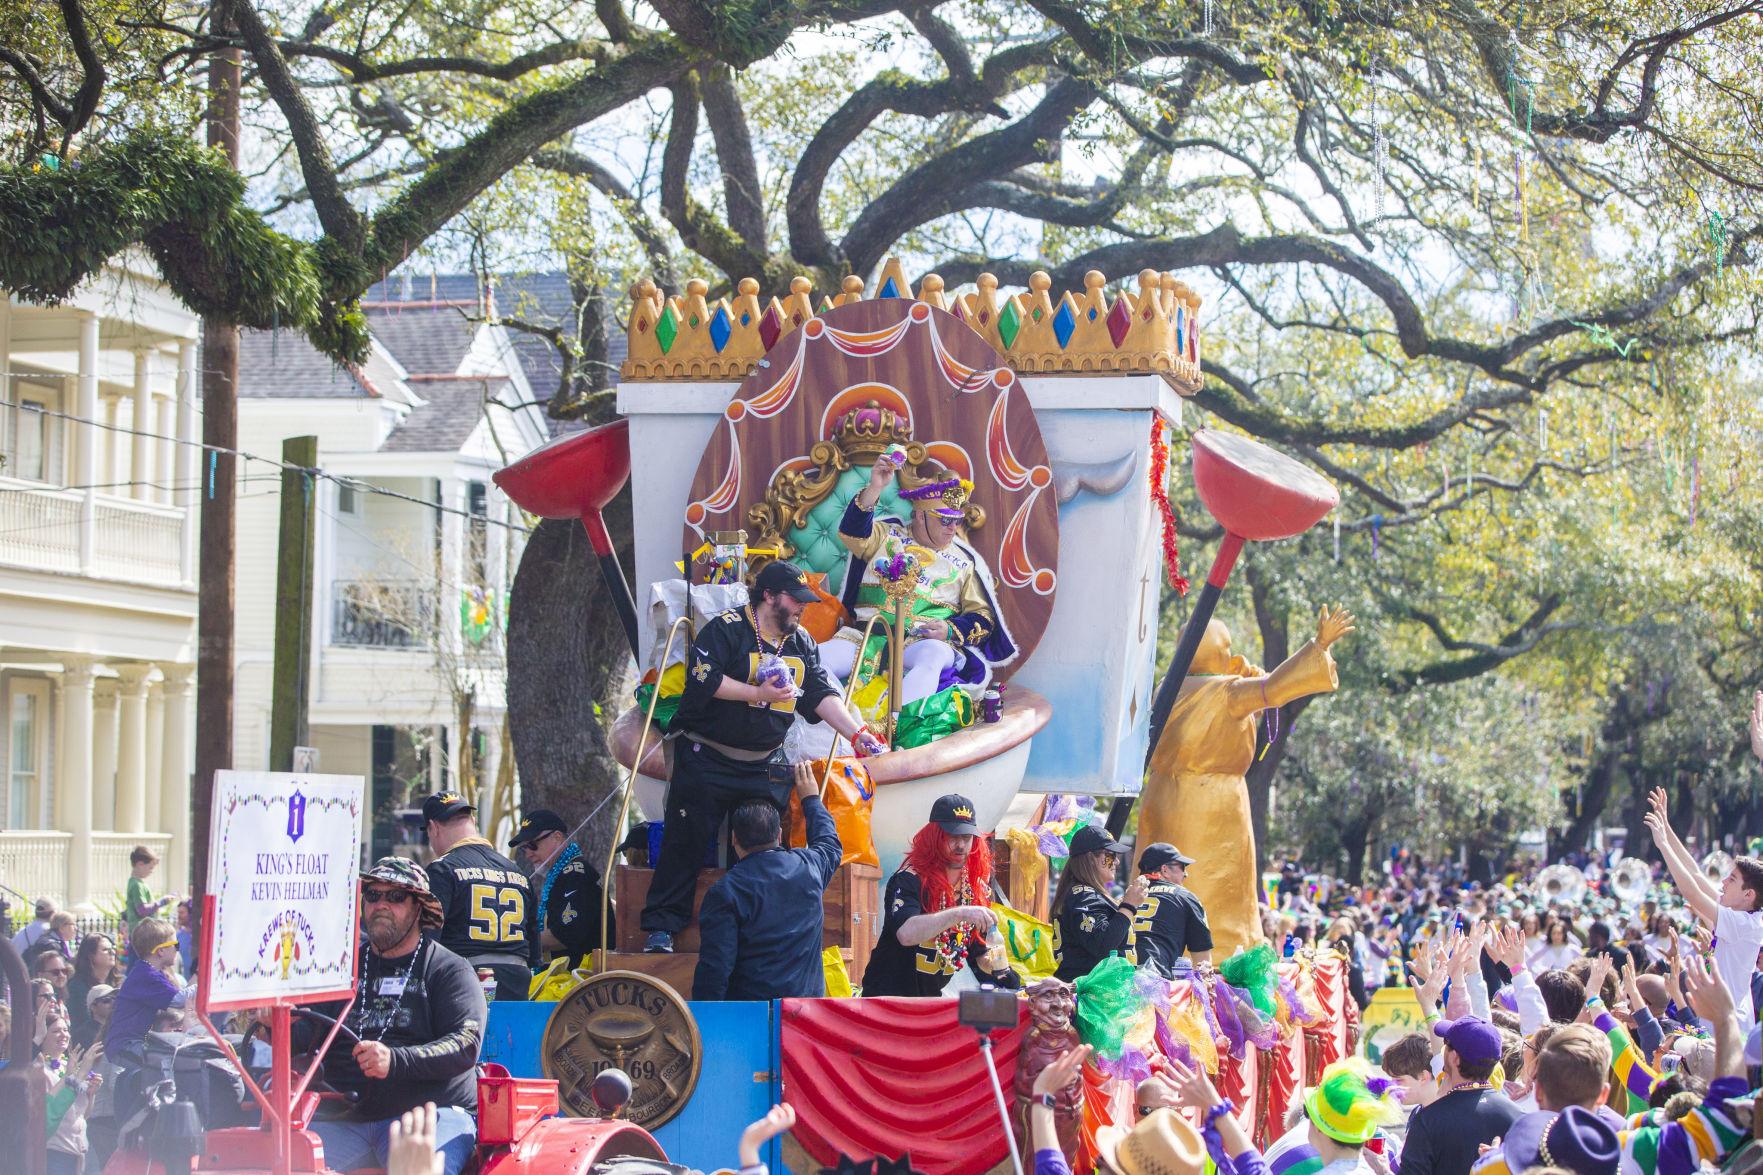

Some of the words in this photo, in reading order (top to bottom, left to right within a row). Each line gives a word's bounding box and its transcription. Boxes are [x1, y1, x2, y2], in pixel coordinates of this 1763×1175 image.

[292, 808, 299, 835] 1
[256, 853, 293, 875] KING'S
[295, 853, 329, 875] FLOAT
[454, 868, 484, 881] TUCKS
[251, 883, 283, 901] KEVIN
[284, 882, 330, 900] HELLMAN
[469, 884, 525, 942] 52
[258, 914, 283, 958] KREWE
[296, 912, 316, 956] TUCKS
[576, 982, 667, 1016] TUCKS
